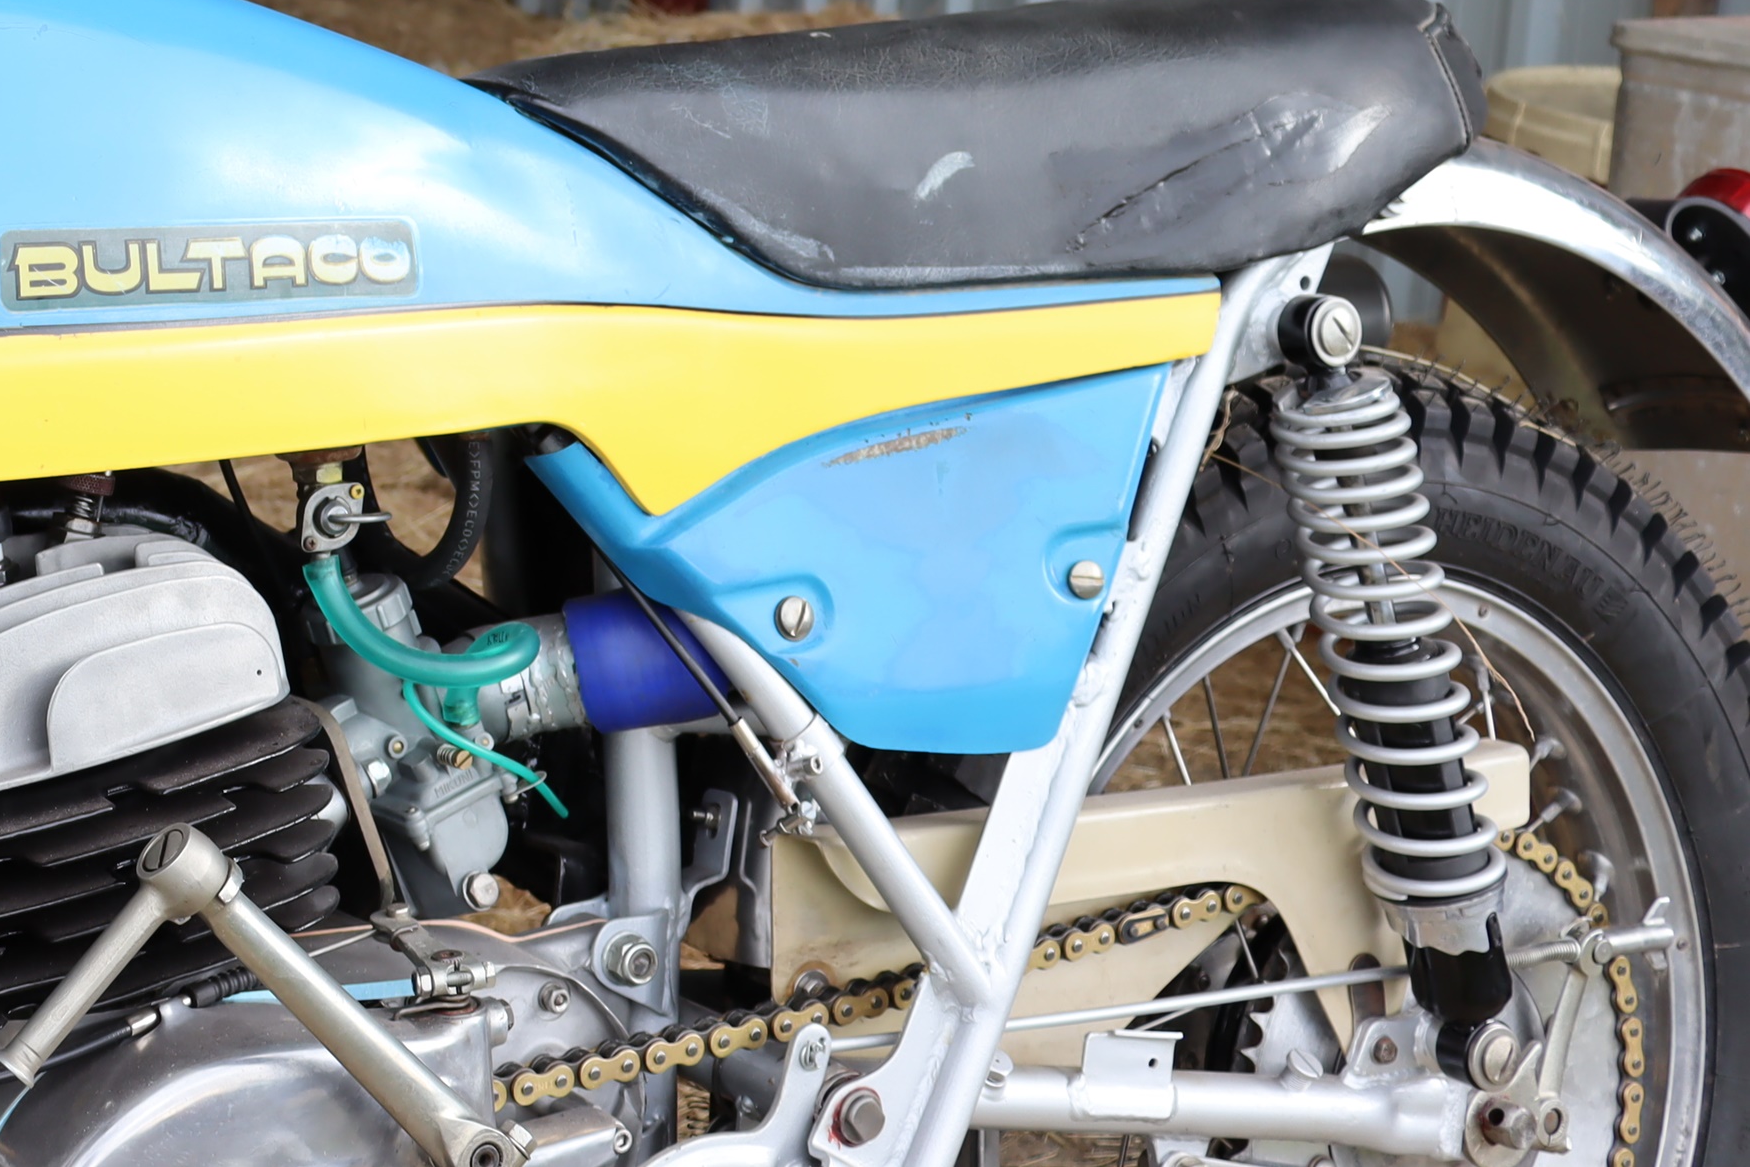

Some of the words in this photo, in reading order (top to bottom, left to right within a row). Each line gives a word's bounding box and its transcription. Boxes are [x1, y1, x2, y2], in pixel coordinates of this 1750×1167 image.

[8, 233, 411, 301] BULTACO
[1435, 507, 1606, 600] HEIDENAU
[433, 768, 474, 799] MIKUNI
